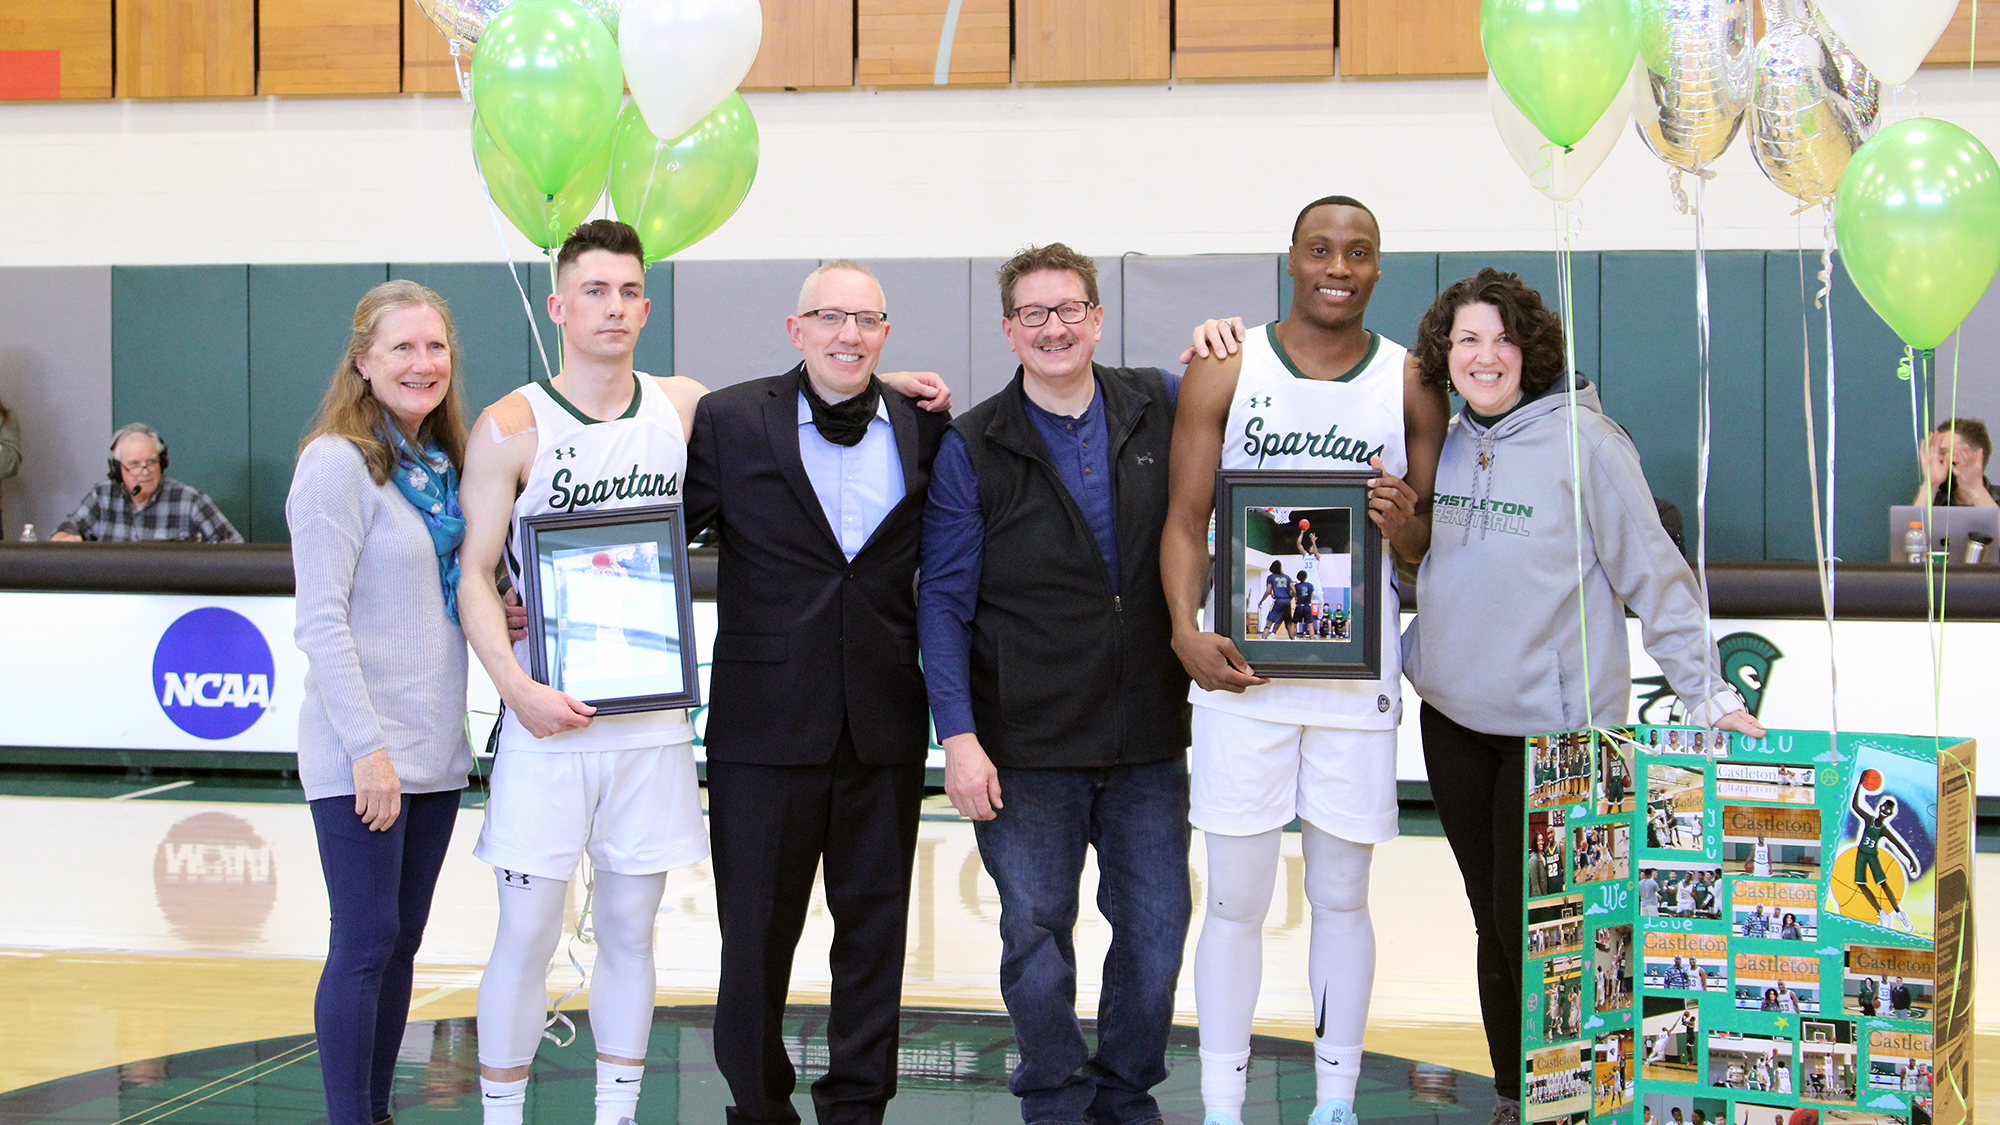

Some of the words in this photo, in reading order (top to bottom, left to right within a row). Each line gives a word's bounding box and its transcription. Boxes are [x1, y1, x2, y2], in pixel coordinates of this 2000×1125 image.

[1244, 416, 1385, 469] Spartans
[549, 464, 678, 513] Spartans
[1433, 505, 1530, 537] ASKETBALL
[163, 672, 270, 708] NCAA
[1718, 765, 1777, 781] Castleton
[1732, 813, 1813, 833] Castleton
[1863, 837, 1876, 848] 33
[1548, 862, 1559, 878] 22
[1600, 883, 1628, 911] We
[1733, 880, 1817, 900] Castleton
[1644, 917, 1694, 931] Love
[1644, 931, 1727, 951] Castleton
[1735, 953, 1819, 974] Castleton
[1857, 952, 1931, 973] Castleton
[1537, 1054, 1578, 1070] Castleton
